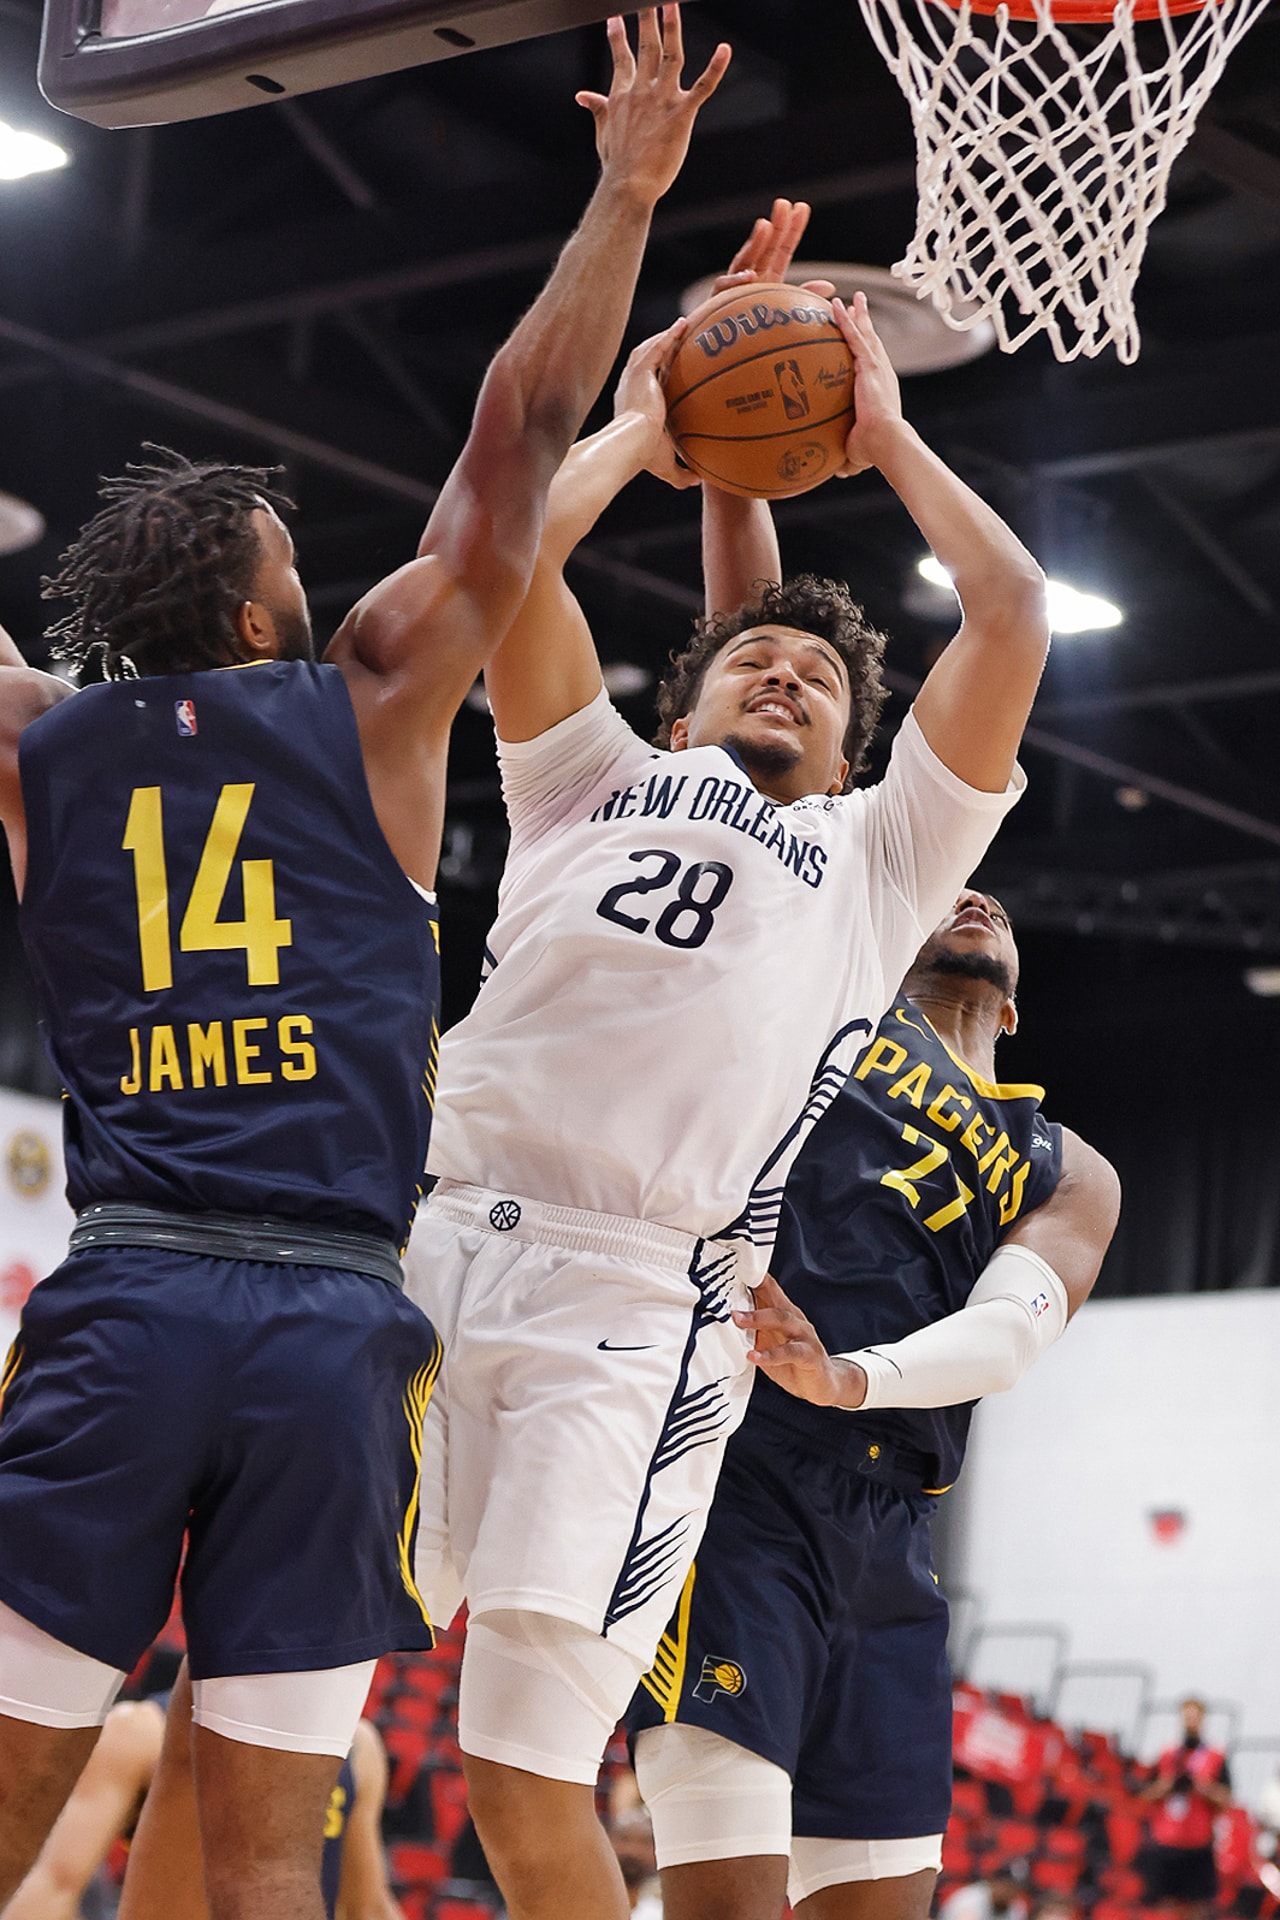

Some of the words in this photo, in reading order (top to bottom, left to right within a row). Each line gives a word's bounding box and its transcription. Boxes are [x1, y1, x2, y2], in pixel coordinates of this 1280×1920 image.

[694, 303, 834, 357] Wilson
[590, 774, 689, 822] NEW
[688, 777, 828, 889] ORLEANS
[122, 783, 292, 992] 14
[596, 848, 734, 949] 28
[120, 1014, 318, 1096] JAMES
[853, 1036, 1031, 1226] PACERS
